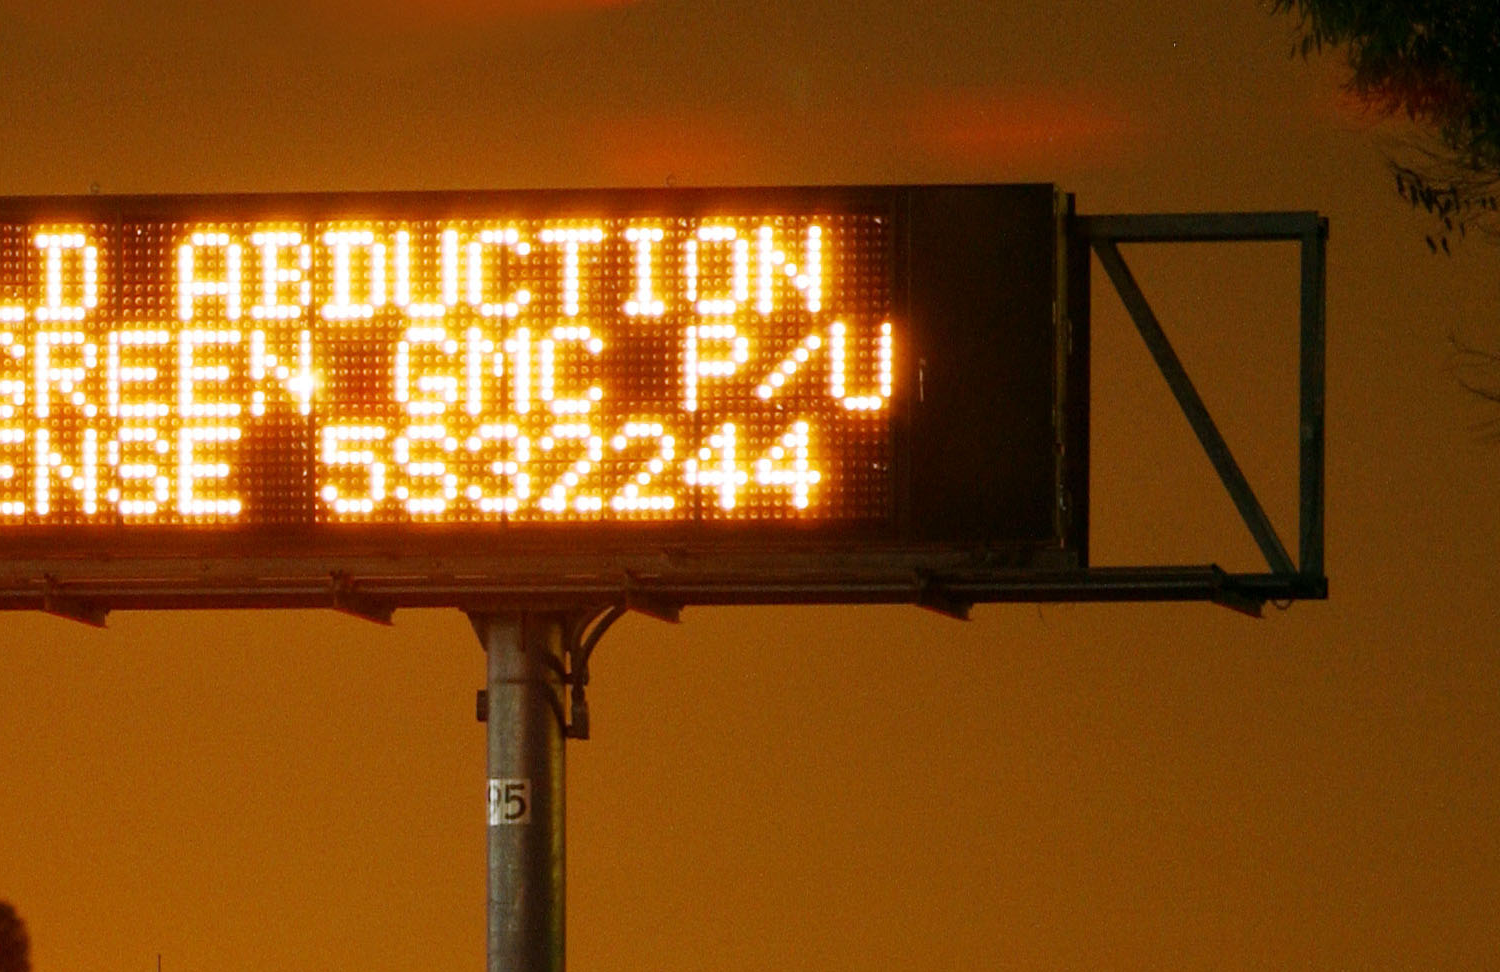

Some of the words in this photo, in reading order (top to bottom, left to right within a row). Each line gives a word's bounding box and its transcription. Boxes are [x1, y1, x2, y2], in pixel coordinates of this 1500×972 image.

[176, 222, 823, 320] ABDUCTION
[393, 321, 604, 416] GMC
[682, 319, 894, 414] P/U
